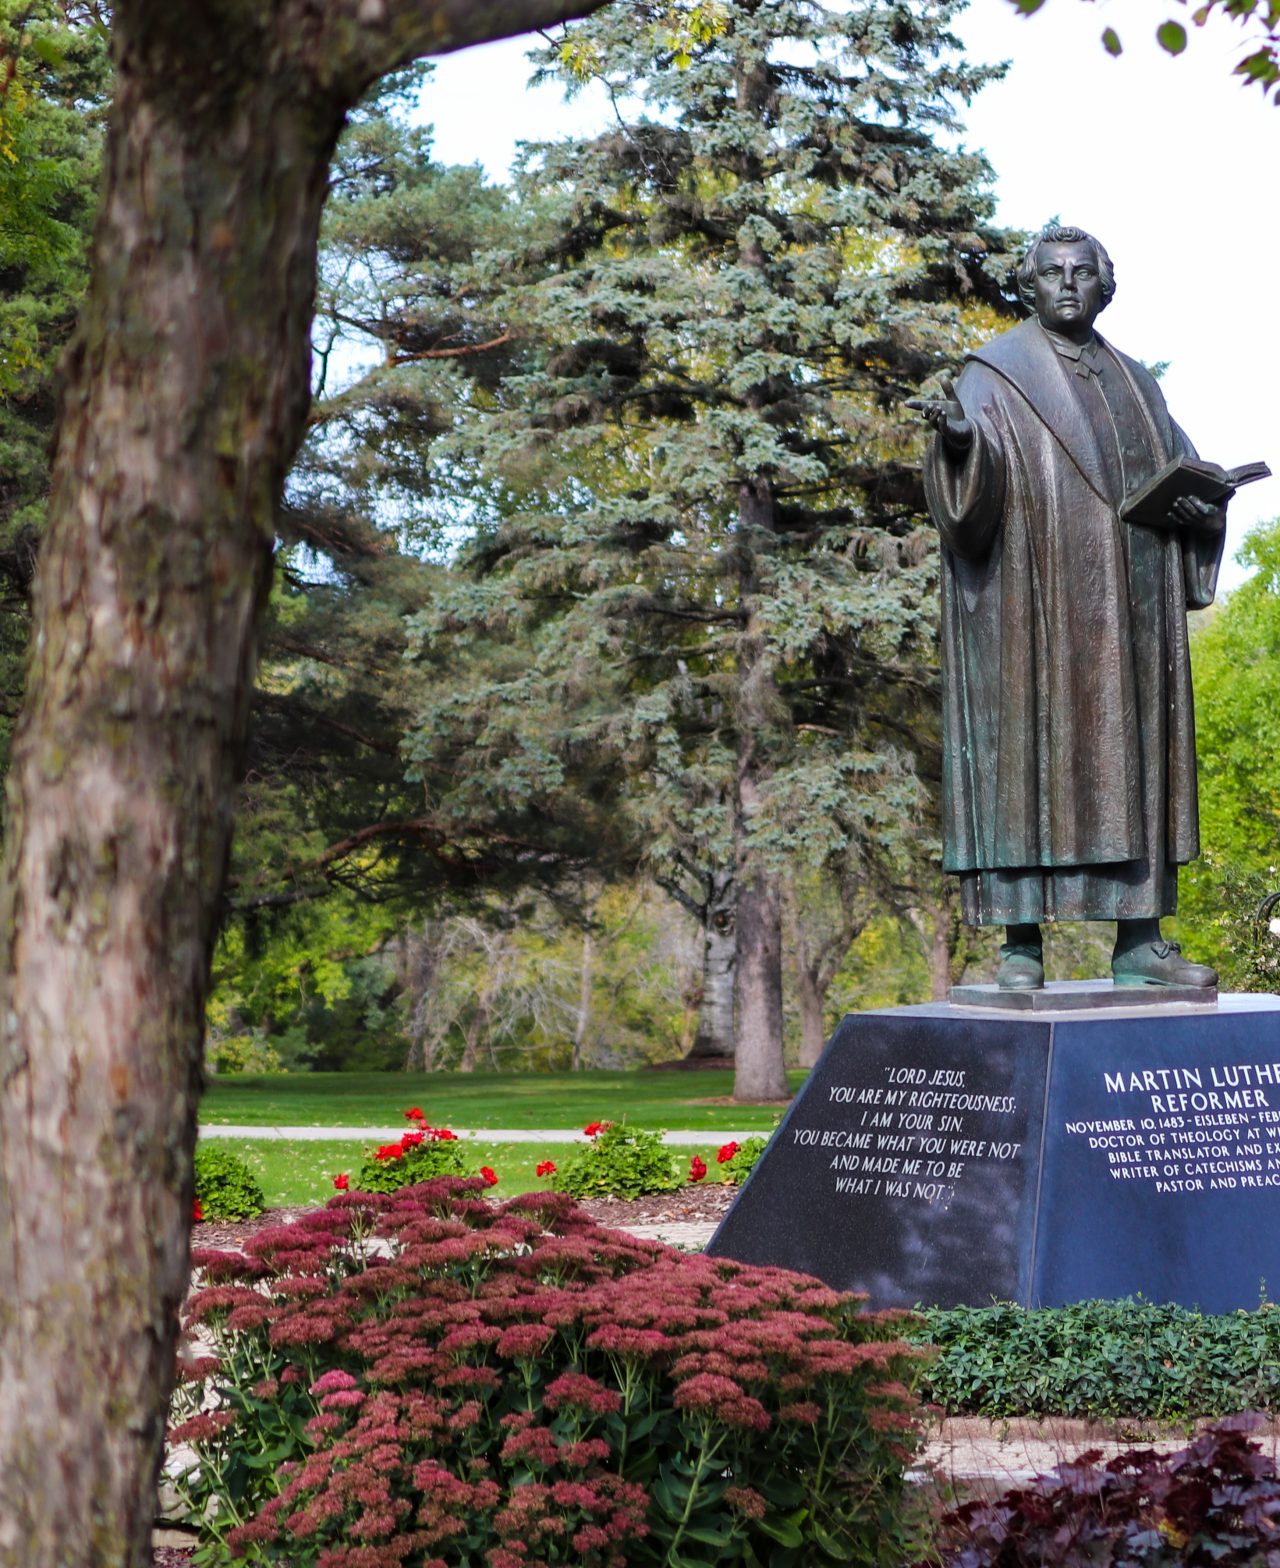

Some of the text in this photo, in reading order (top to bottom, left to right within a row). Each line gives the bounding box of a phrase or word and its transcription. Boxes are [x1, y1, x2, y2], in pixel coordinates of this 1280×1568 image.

[1104, 1068, 1203, 1093] MARTIN
[828, 1087, 856, 1102] YOU
[857, 1089, 881, 1104] ARE
[884, 1090, 907, 1105] MY
[1151, 1089, 1270, 1113] REFORMER
[860, 1111, 867, 1126] I
[870, 1112, 893, 1127] AM
[898, 1113, 932, 1130] YOUR
[1065, 1119, 1135, 1134] NOVEMBER
[1159, 1115, 1185, 1129] 1483
[1194, 1114, 1249, 1127] EISLEBEN
[793, 1129, 1021, 1159] YOU BECAME WHAT YOU WERE NOT
[1089, 1135, 1145, 1148] DOCTOR
[1150, 1133, 1166, 1145] OF
[1171, 1129, 1241, 1144] THEOLOGY
[1247, 1127, 1260, 1139] AT
[1108, 1151, 1142, 1164] BIBLE
[1145, 1145, 1230, 1161] TRANSLATOR
[1236, 1143, 1263, 1156] AND
[830, 1155, 964, 1178] AND MADE ME TO BE
[1109, 1166, 1159, 1180] WRITER
[1163, 1164, 1180, 1176] OF
[1184, 1159, 1263, 1175] CATECHISMS
[835, 1177, 873, 1194] WHAT
[874, 1180, 881, 1194] I
[885, 1181, 912, 1198] WAS
[1156, 1178, 1205, 1193] PASTOR
[1210, 1177, 1237, 1189] AND
